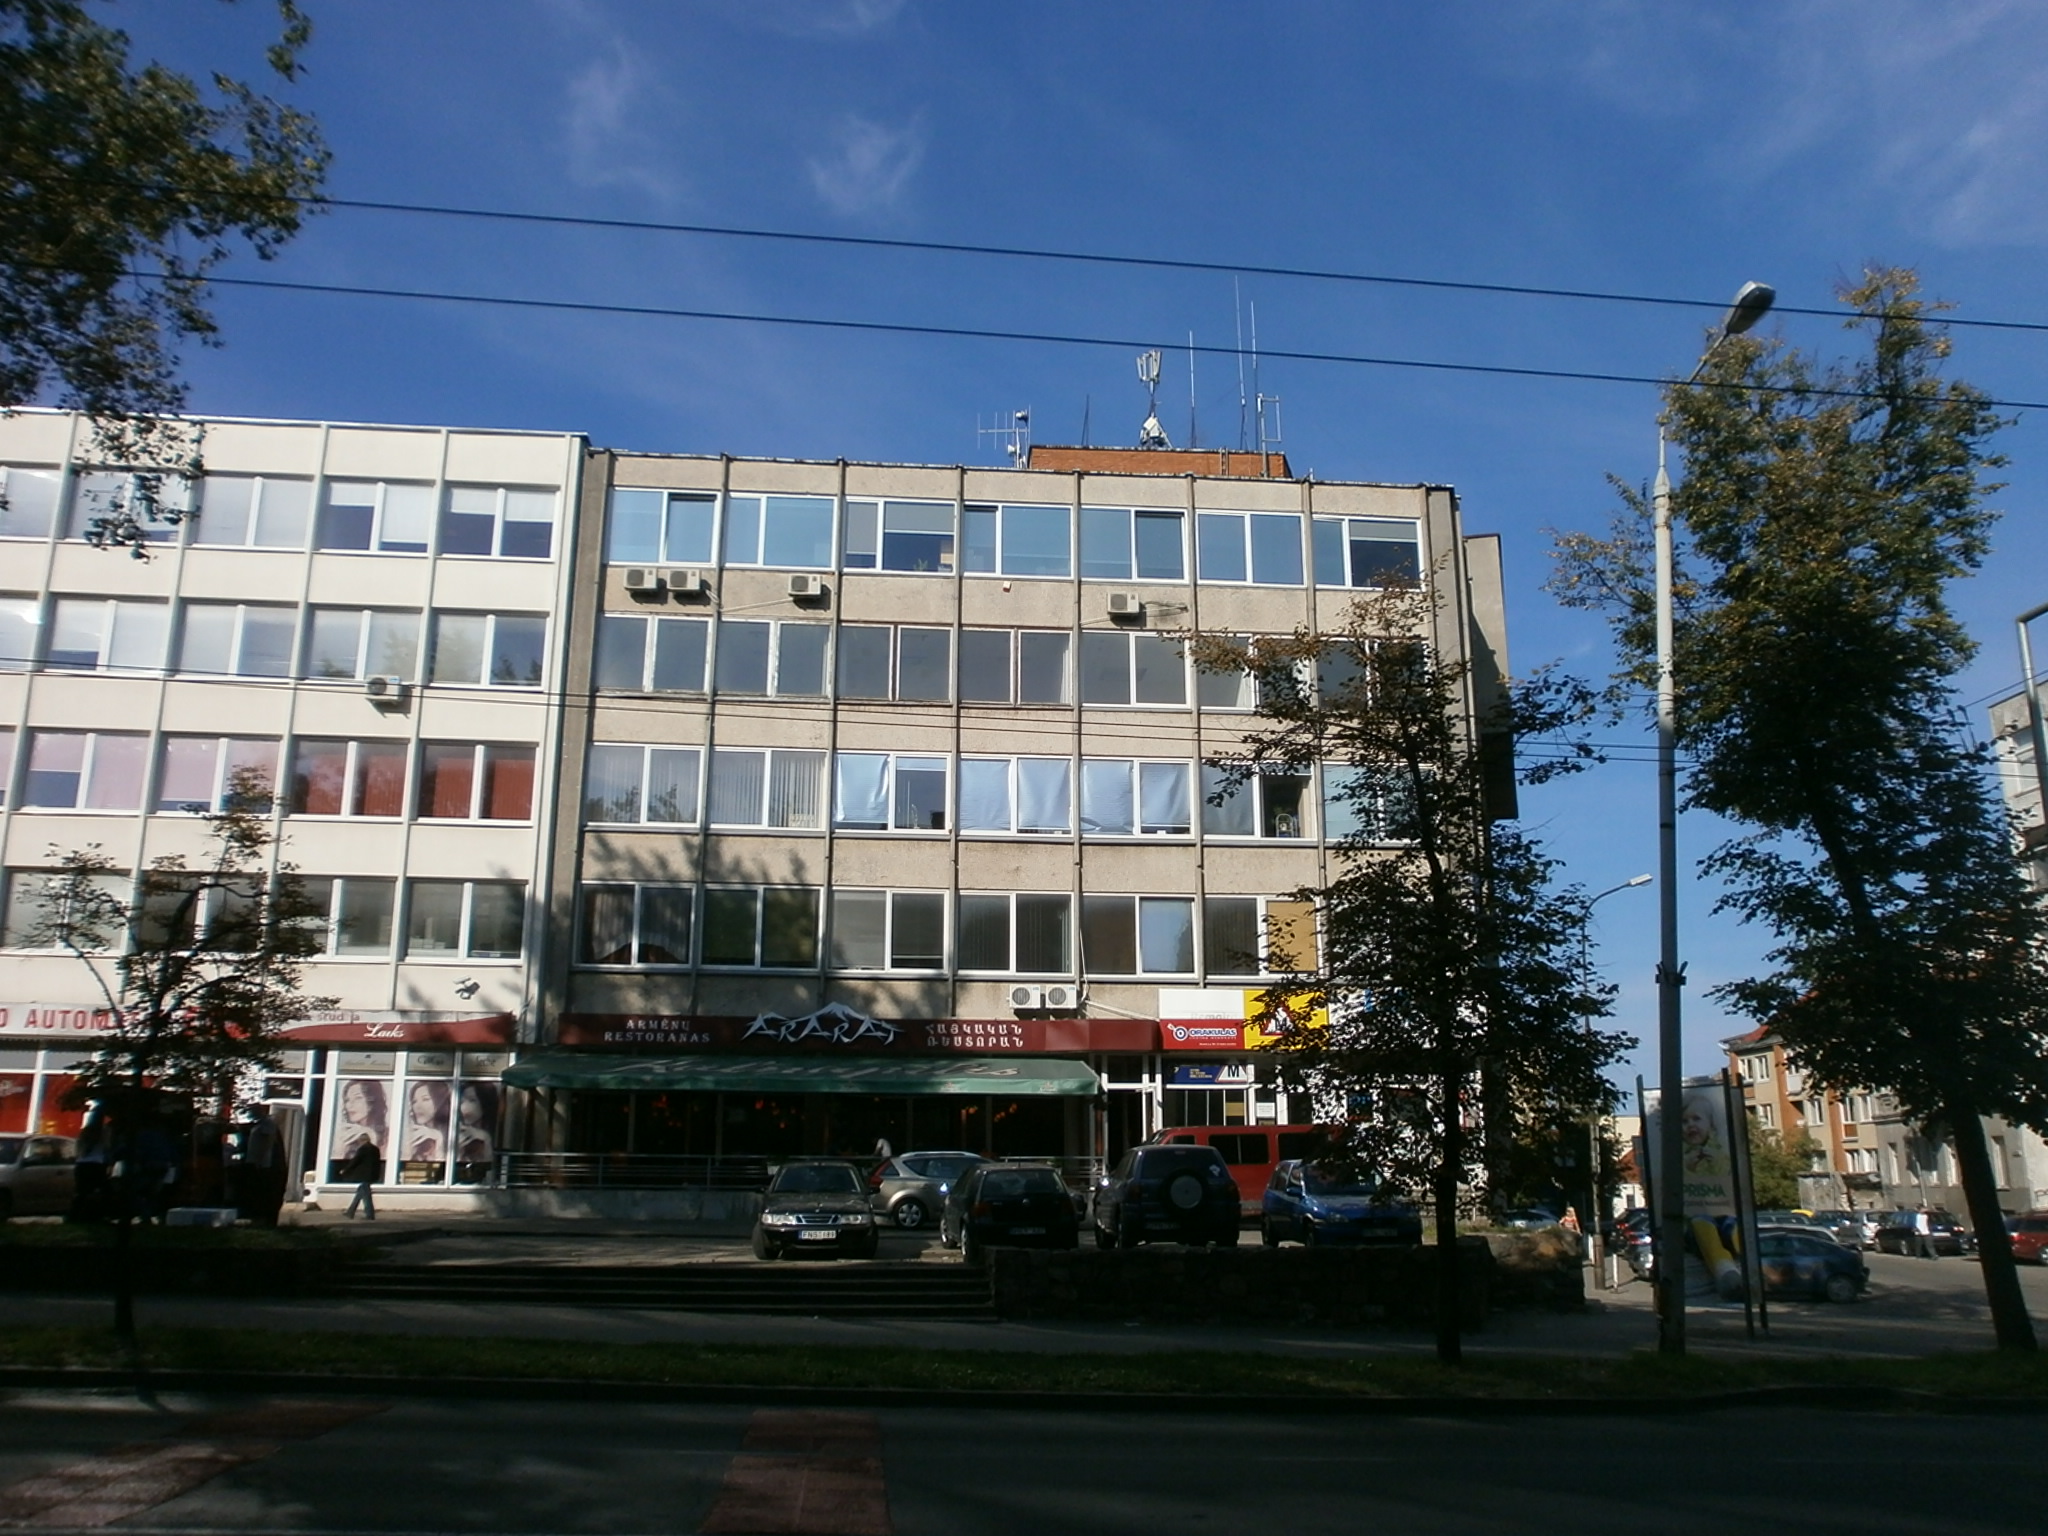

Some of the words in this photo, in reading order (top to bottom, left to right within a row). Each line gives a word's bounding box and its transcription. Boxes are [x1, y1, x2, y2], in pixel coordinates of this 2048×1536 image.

[740, 1004, 904, 1046] ARARAT
[925, 1022, 1022, 1035] ՀԱՅԿԱԿԱՆ
[603, 1031, 711, 1043] RESTORANAS
[1189, 1028, 1237, 1037] ORAKULAS
[1228, 1064, 1239, 1077] M
[1682, 1183, 1726, 1198] PRISMA
